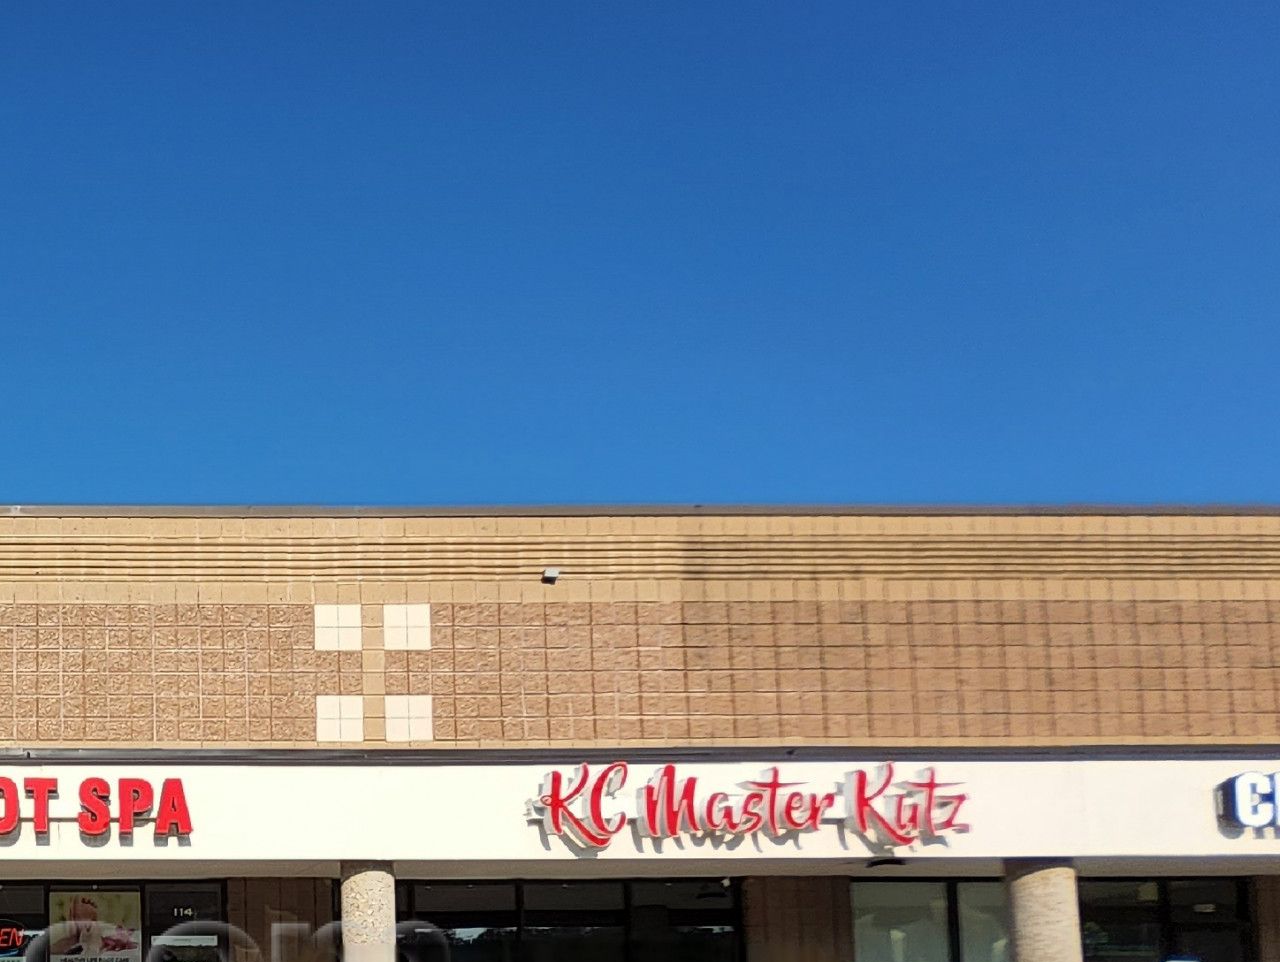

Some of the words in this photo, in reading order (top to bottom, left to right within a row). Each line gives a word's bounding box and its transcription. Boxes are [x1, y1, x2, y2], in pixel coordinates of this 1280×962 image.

[77, 776, 194, 836] SPA
[536, 760, 629, 848] KC
[638, 762, 837, 837] Master
[844, 760, 971, 847] Kutz
[1228, 770, 1280, 830] C
[173, 907, 194, 917] 114
